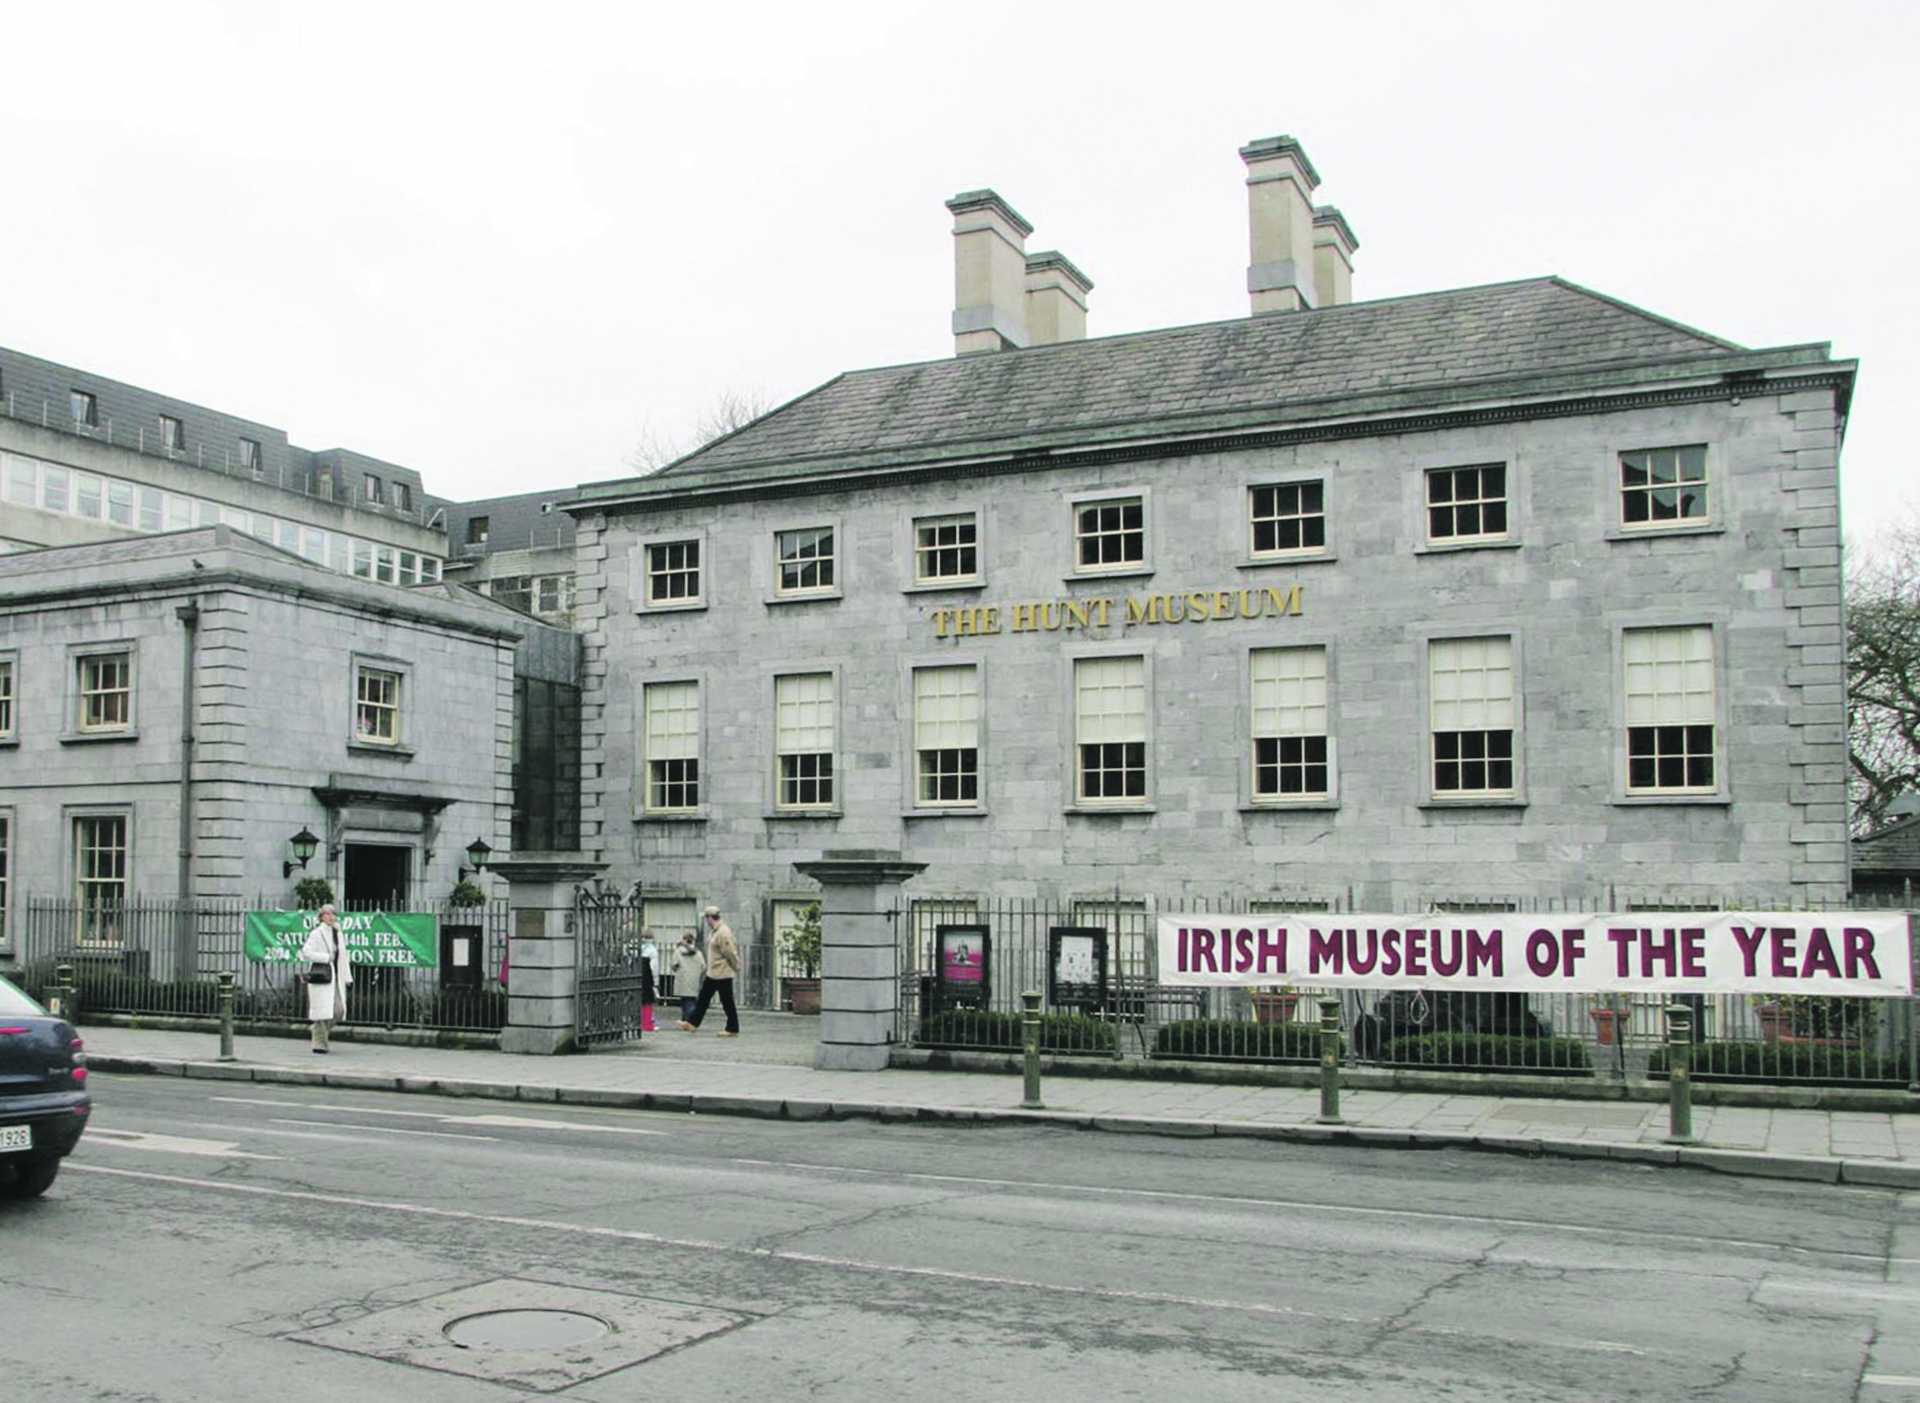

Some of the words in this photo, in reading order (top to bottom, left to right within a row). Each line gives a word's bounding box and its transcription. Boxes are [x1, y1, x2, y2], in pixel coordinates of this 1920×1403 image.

[931, 607, 1001, 639] THE
[1011, 599, 1113, 633] HUNT
[1124, 586, 1304, 627] MUSEUM
[342, 915, 374, 930] DAY
[375, 932, 404, 947] FEB.
[379, 949, 417, 964] FREE
[1177, 928, 1288, 973] IRISH
[1309, 928, 1504, 977] MUSEUM
[1525, 928, 1586, 978] OF
[1607, 928, 1707, 978] THE
[1730, 927, 1882, 979] YEAR
